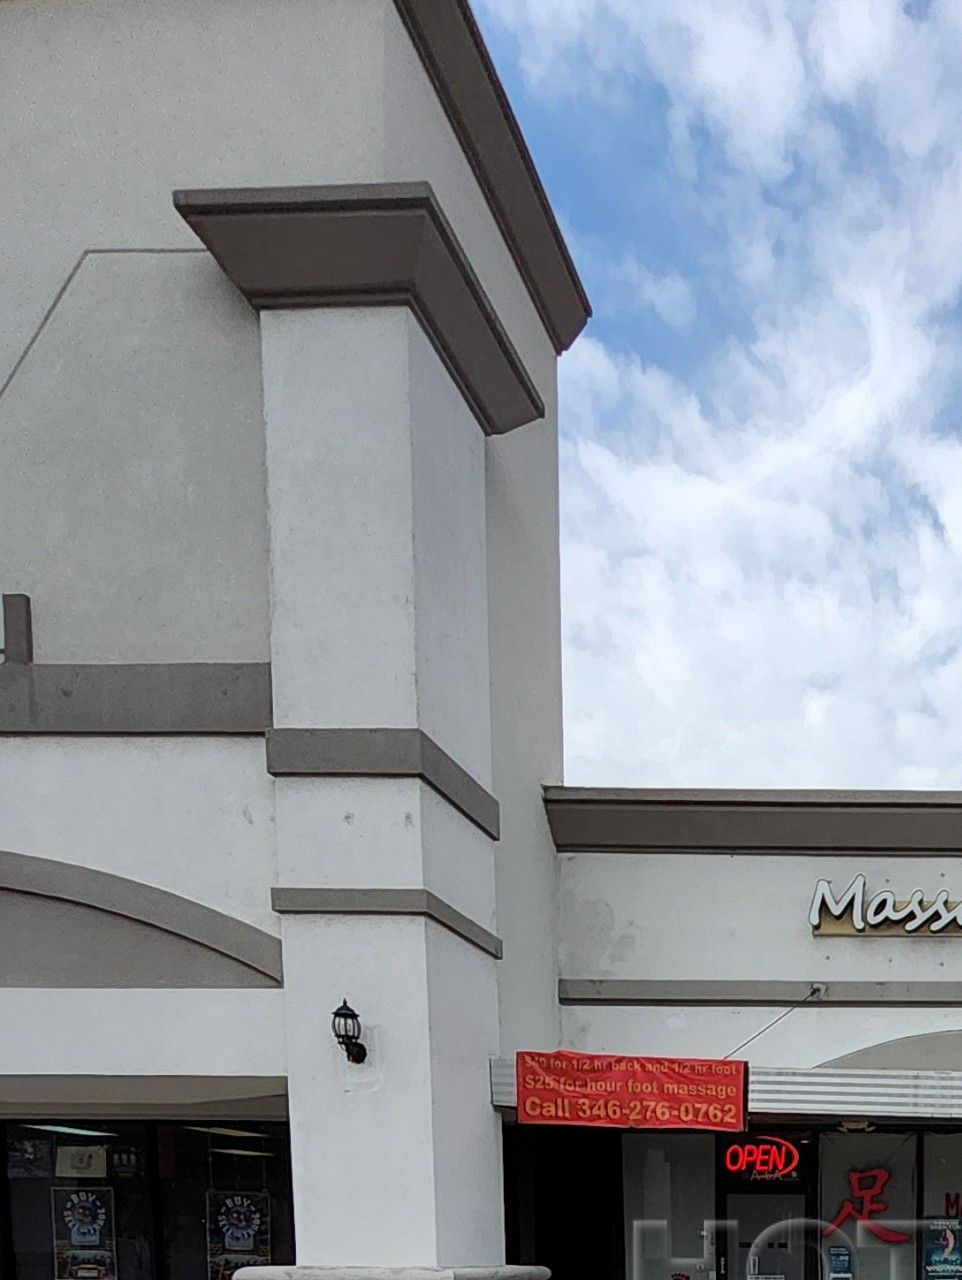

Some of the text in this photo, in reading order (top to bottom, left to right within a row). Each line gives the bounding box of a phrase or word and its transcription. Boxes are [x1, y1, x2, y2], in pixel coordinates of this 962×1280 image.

[550, 1058, 567, 1069] for
[571, 1058, 590, 1070] 1/2
[594, 1060, 609, 1071] hr
[611, 1059, 641, 1073] back
[645, 1061, 669, 1073] and
[673, 1062, 691, 1074] 1/2
[695, 1063, 708, 1075] hr
[711, 1063, 737, 1075] foot
[559, 1077, 583, 1091] for
[586, 1078, 623, 1093] hour
[627, 1079, 657, 1093] foot
[663, 1083, 737, 1098] massage
[524, 1096, 737, 1124] Call 346-276-0762
[726, 1144, 785, 1171] OPEN
[821, 1167, 912, 1244] 足
